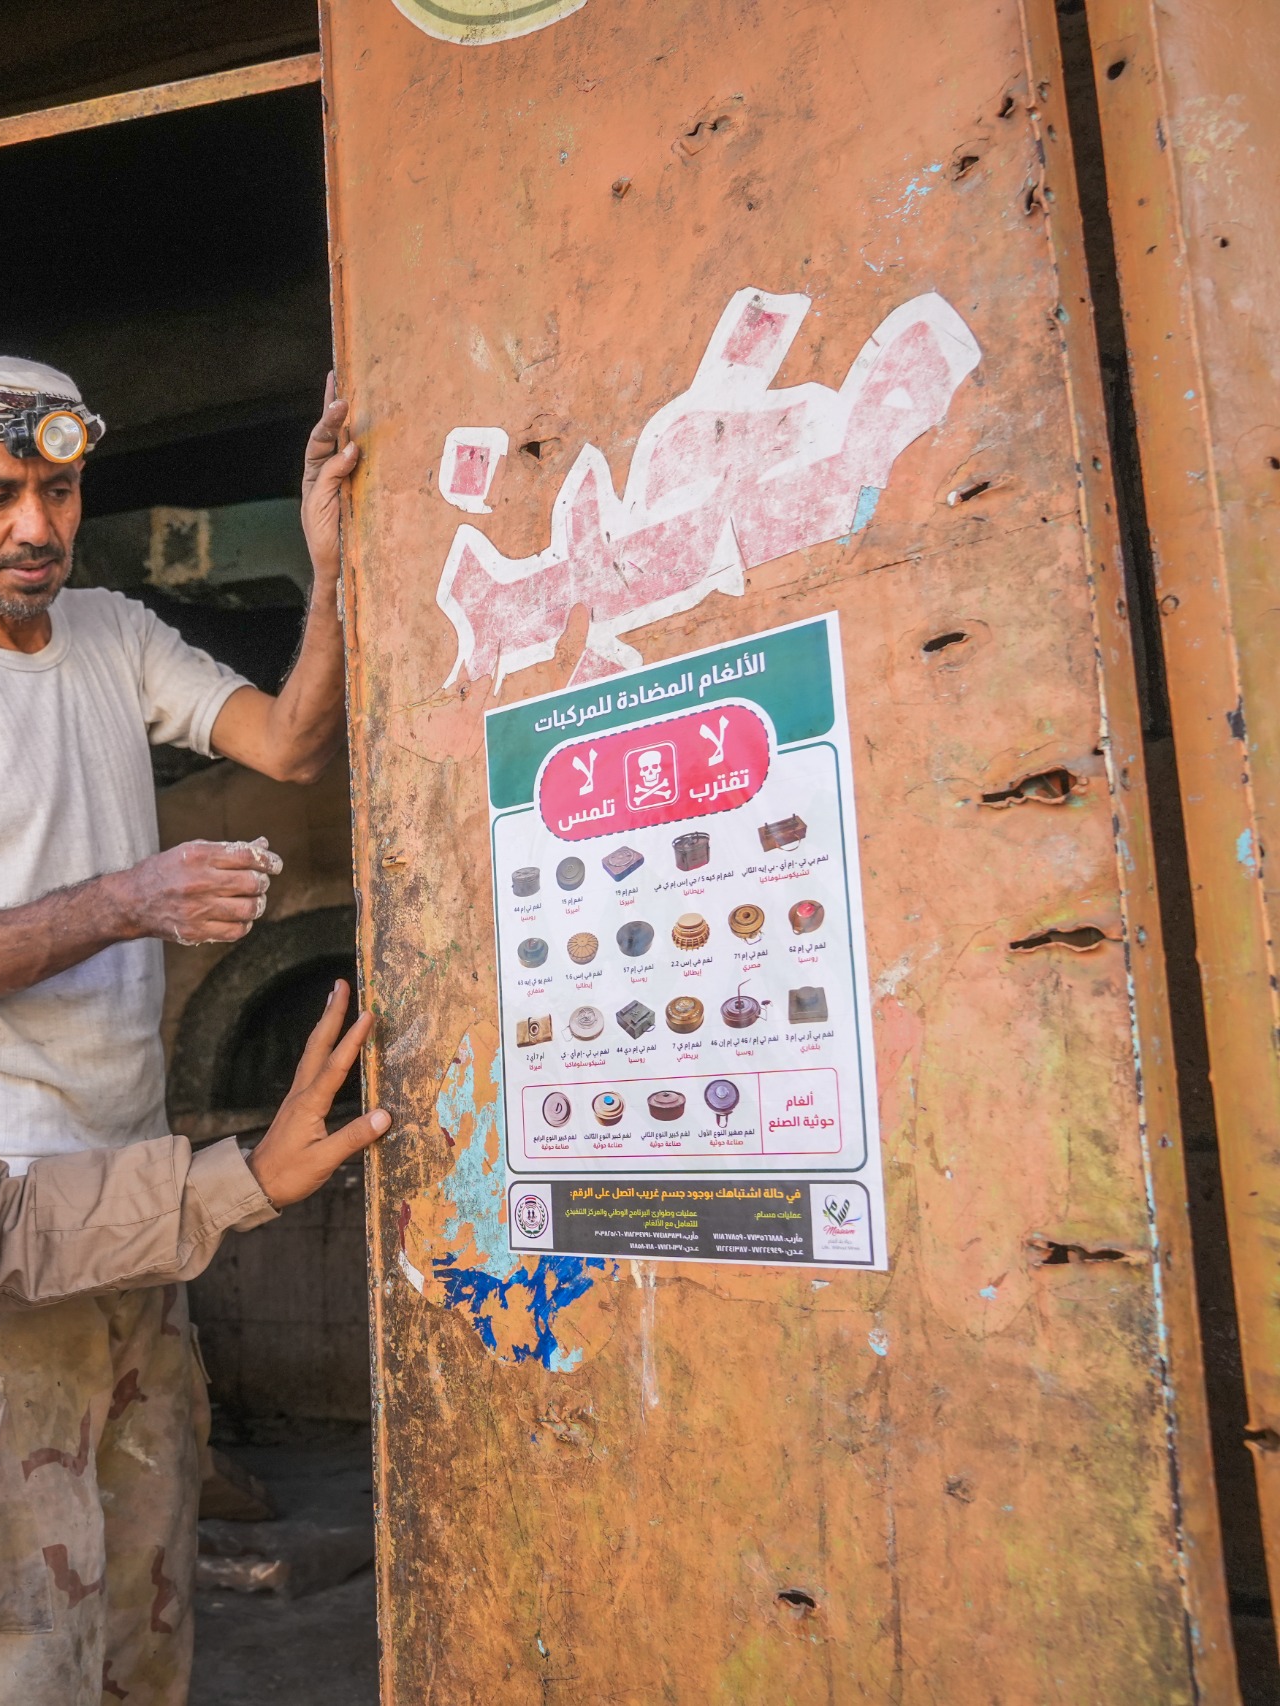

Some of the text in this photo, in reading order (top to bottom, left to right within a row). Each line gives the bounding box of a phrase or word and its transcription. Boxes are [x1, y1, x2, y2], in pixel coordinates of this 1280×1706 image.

[534, 651, 766, 732] الألغام المضادة للمركبات
[699, 715, 730, 767] لا
[571, 748, 598, 796] لا
[689, 768, 750, 803] تقترب
[558, 798, 616, 832] تلمس
[785, 1090, 814, 1112] ألغام
[768, 1114, 835, 1133] حوثية الصنع
[569, 1186, 802, 1204] في حالة اشتباهك بوجود جسم غريب اتصل على الرقم:
